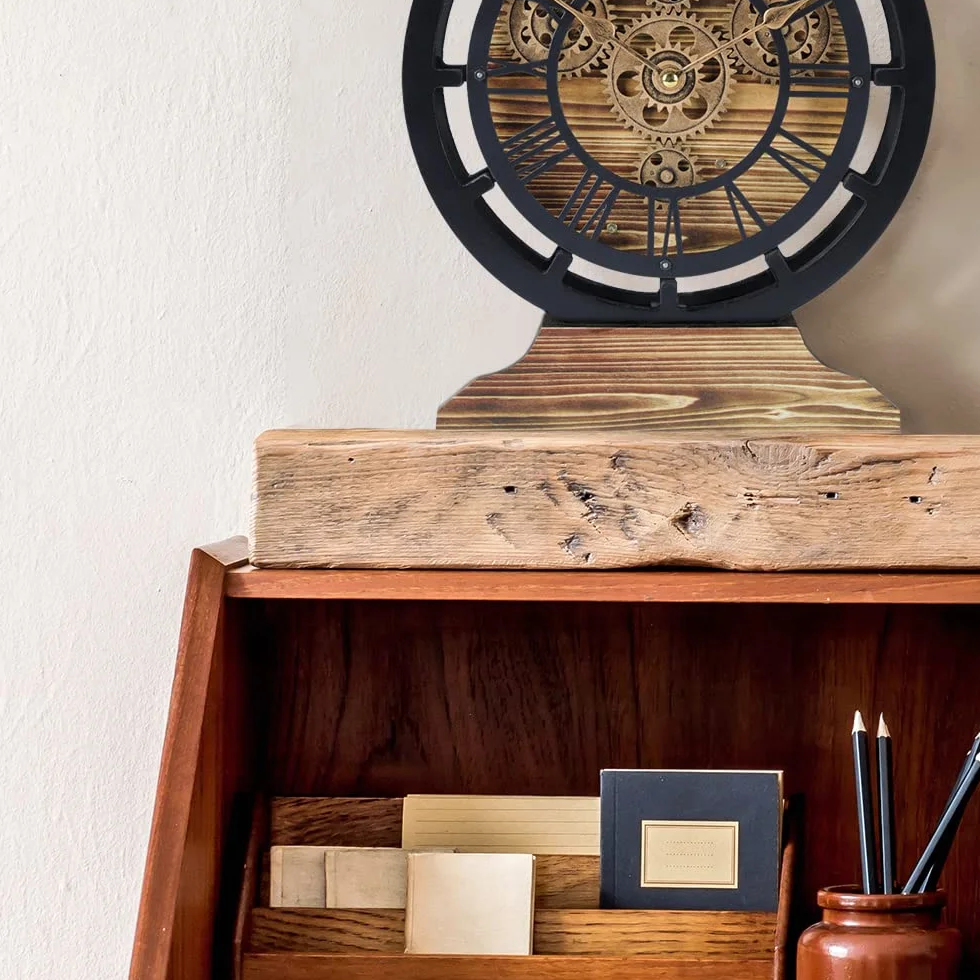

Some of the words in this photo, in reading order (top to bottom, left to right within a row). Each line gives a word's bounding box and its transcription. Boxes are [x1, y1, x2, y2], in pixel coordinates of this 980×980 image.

[488, 58, 549, 95] IX
[787, 63, 850, 97] III
[502, 117, 572, 183] VIII
[767, 128, 833, 187] IV
[558, 170, 620, 240] VII
[647, 198, 683, 256] VI
[724, 184, 767, 239] V
